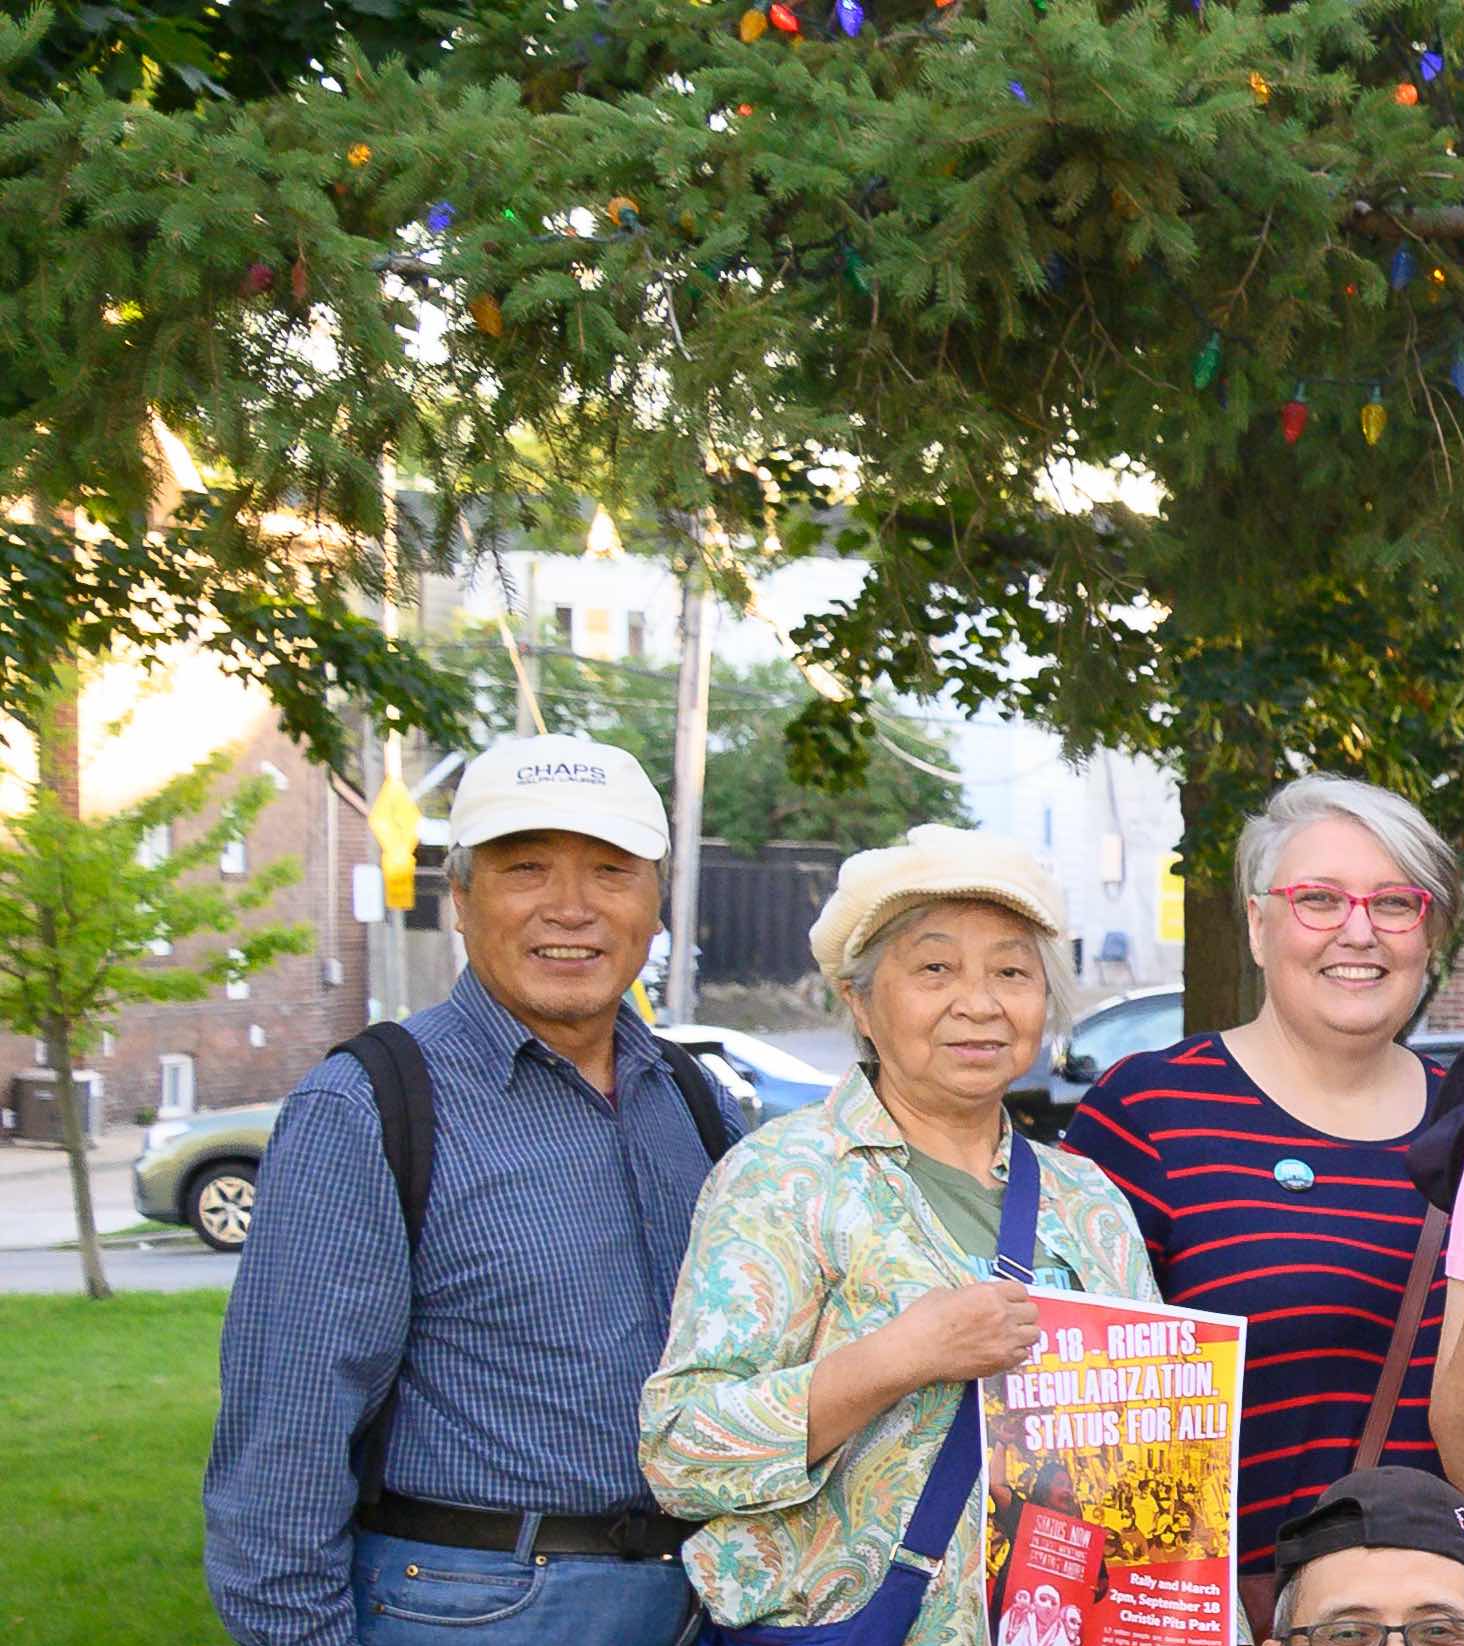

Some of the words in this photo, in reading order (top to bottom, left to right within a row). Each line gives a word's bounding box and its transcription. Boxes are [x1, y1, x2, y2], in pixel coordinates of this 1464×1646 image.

[517, 764, 606, 780] CHAPS
[1056, 1328, 1084, 1363] 18
[1107, 1320, 1202, 1362] RIGHTS.
[1006, 1362, 1218, 1411] REGULARIZATION.
[1024, 1411, 1120, 1451] STATUS
[1128, 1407, 1172, 1446] FOR
[1178, 1403, 1228, 1441] ALL!
